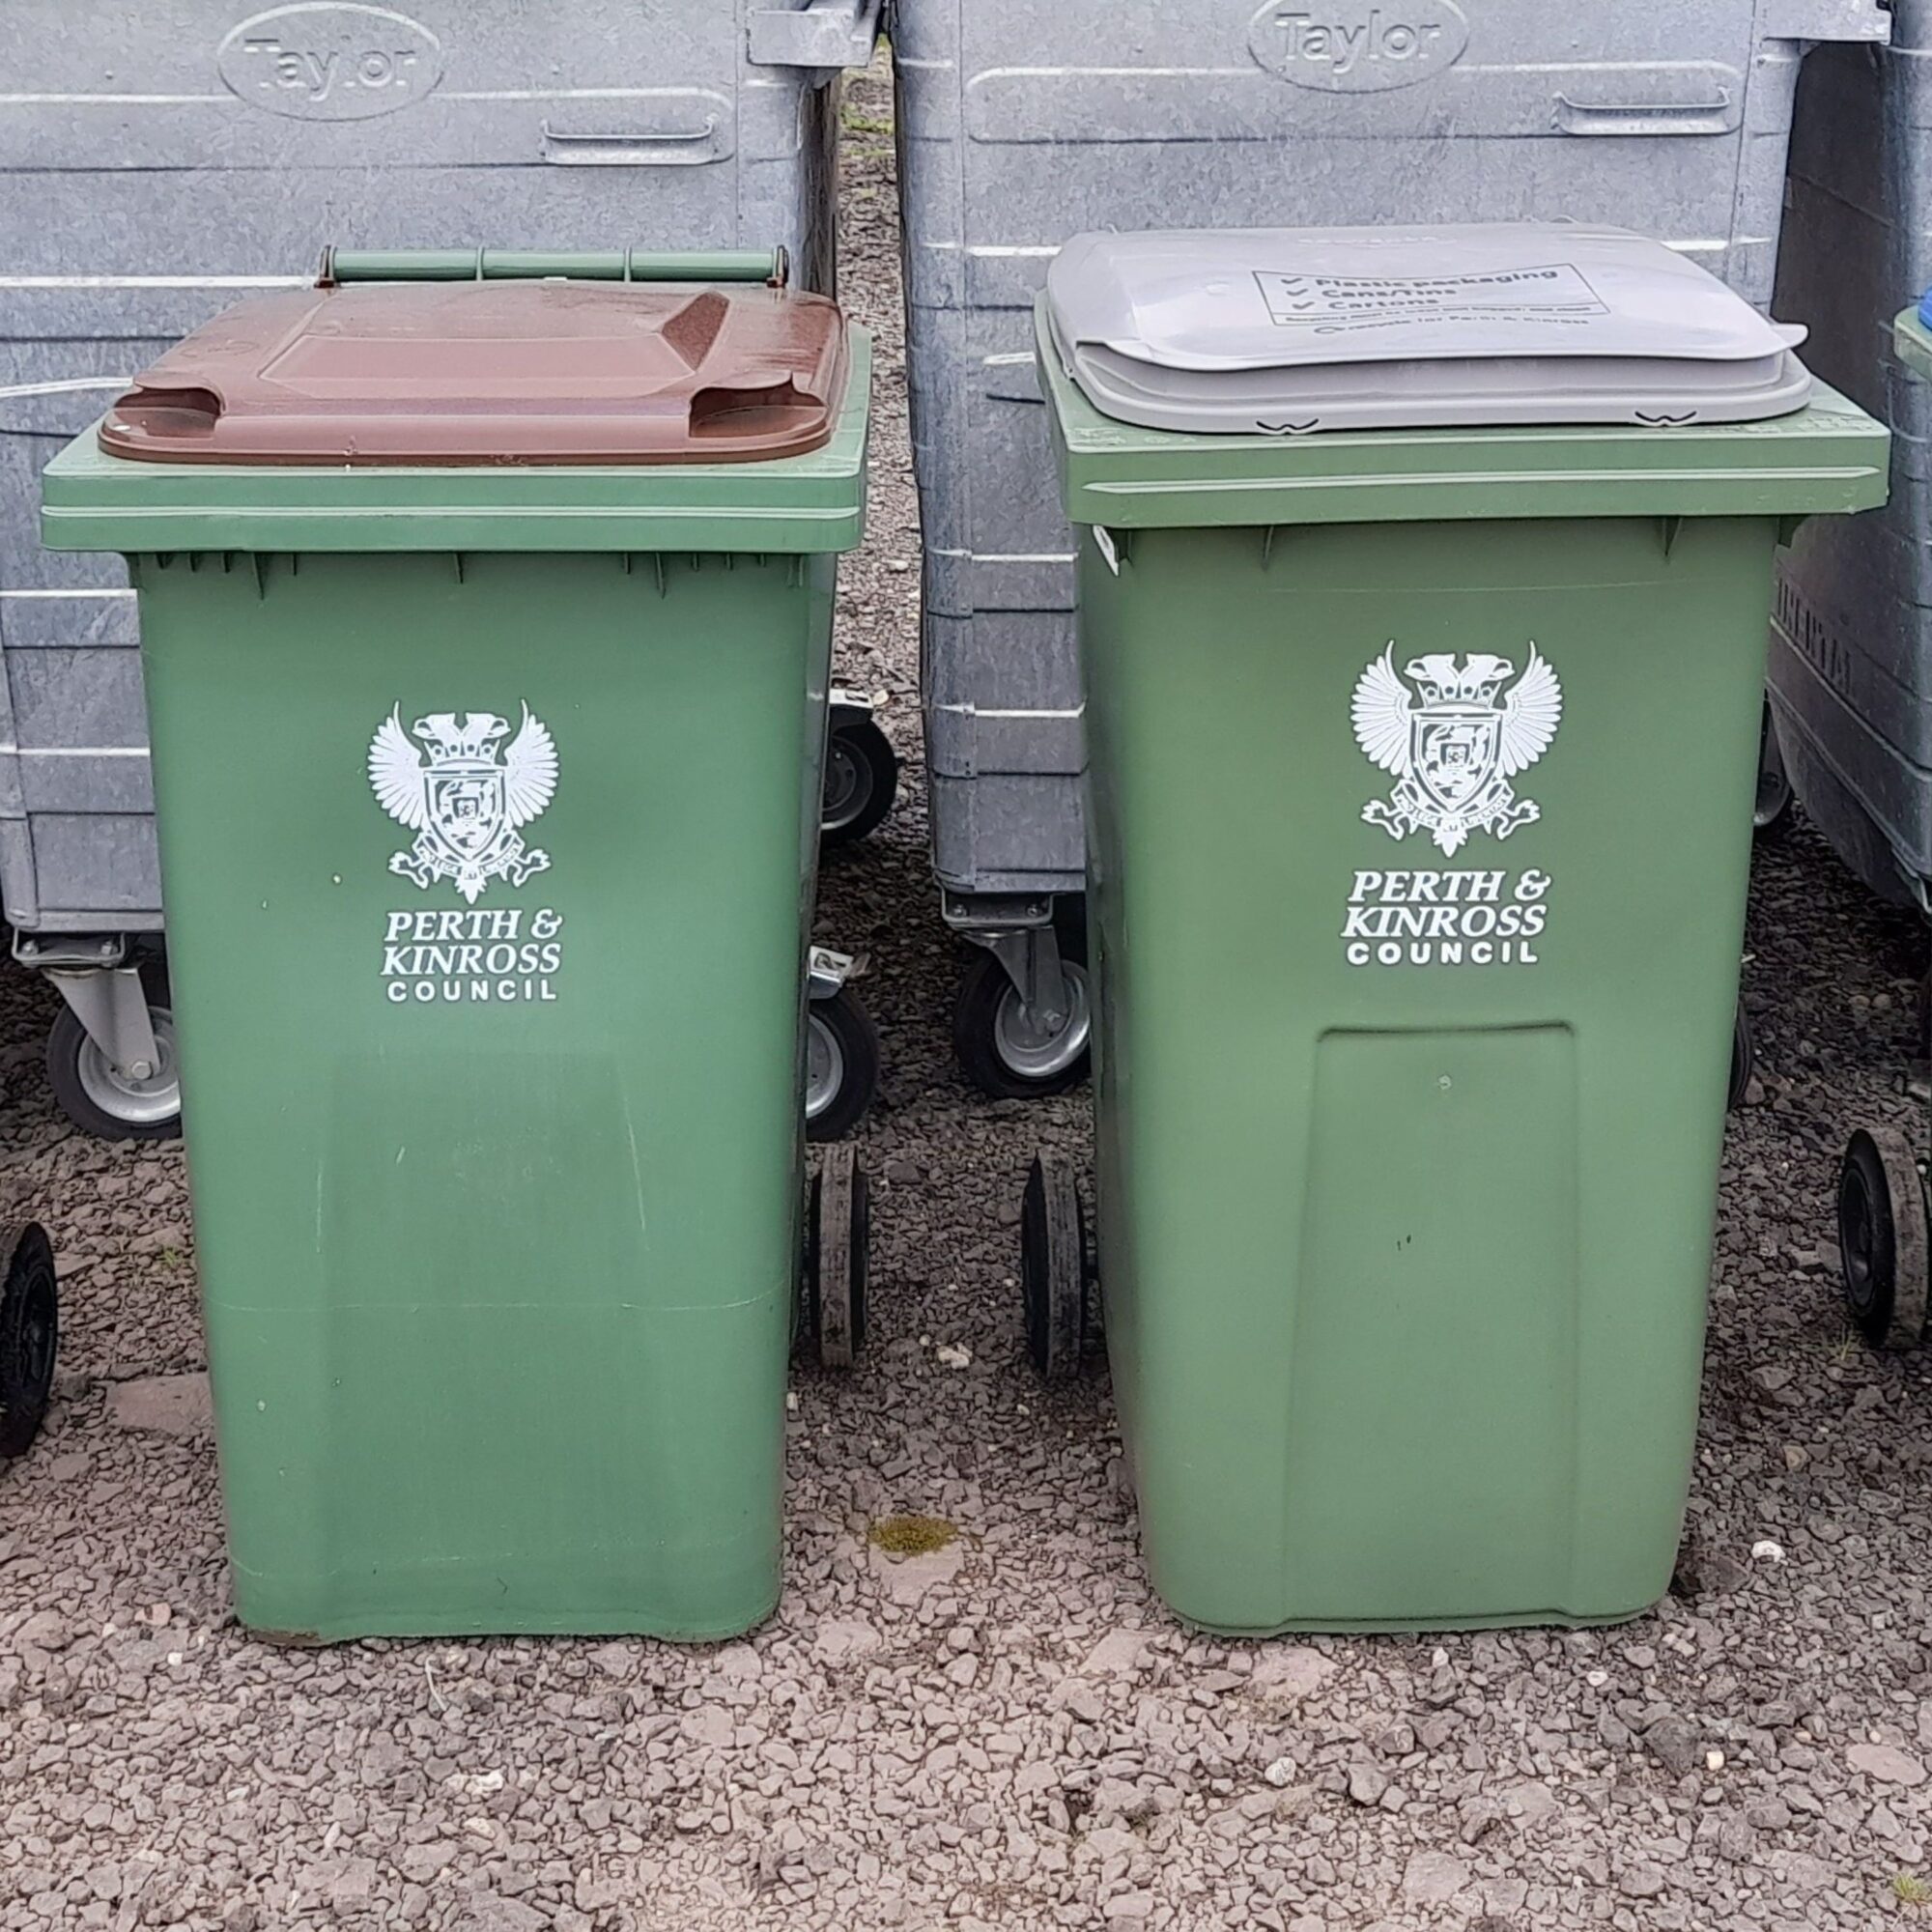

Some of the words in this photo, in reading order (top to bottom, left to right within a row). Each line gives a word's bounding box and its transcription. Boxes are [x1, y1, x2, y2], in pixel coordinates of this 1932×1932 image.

[1274, 9, 1441, 73] Taylor
[243, 34, 416, 101] Taylor
[1316, 278, 1406, 288] Plastic
[1412, 270, 1558, 288] packaging
[1321, 289, 1457, 299] Cans/Tins
[1328, 299, 1439, 310] Cartons
[1348, 870, 1506, 903] PERTH
[1514, 868, 1551, 903] &
[384, 909, 523, 942] PERTH
[530, 908, 563, 941] &
[1340, 905, 1547, 938] KINROSS
[381, 943, 562, 976] KINROSS
[1347, 941, 1539, 965] COUNCIL
[387, 979, 557, 1003] COUNCIL
